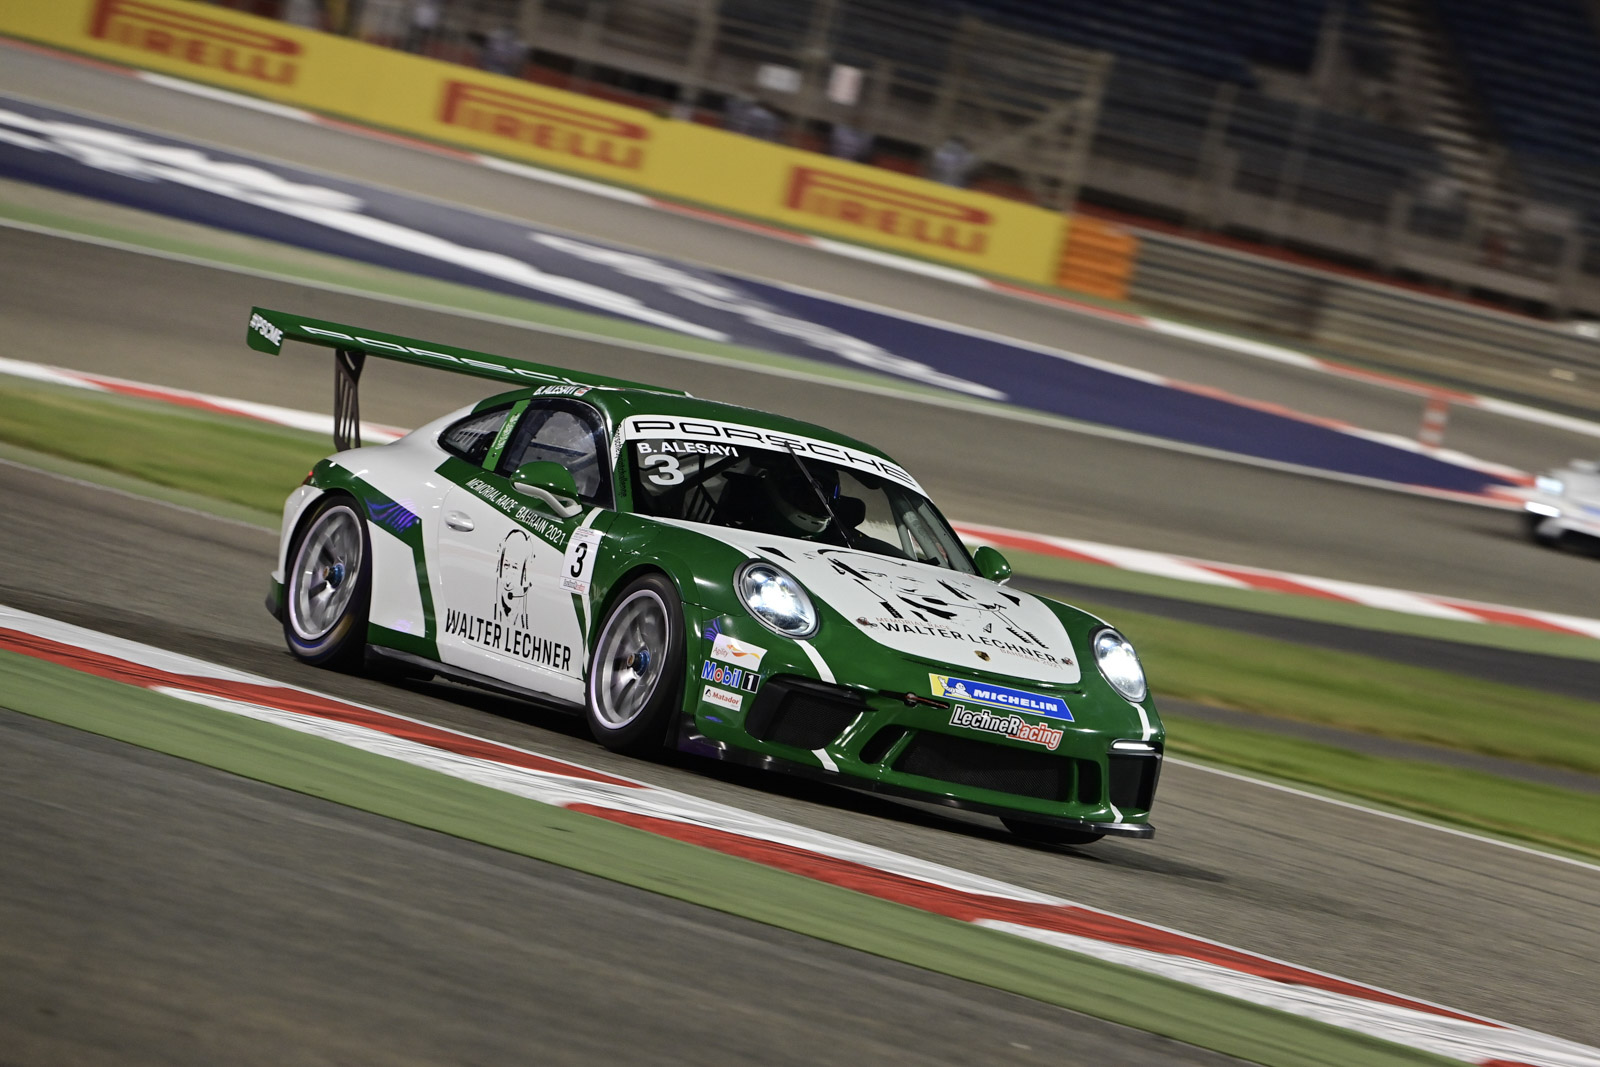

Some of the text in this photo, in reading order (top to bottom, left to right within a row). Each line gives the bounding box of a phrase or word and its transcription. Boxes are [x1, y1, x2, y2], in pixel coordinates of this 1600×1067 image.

[88, 0, 304, 86] PIRELLI
[437, 78, 650, 170] PIRELLI
[779, 165, 992, 254] PIRELLI
[632, 420, 917, 489] PORSCHE
[636, 441, 739, 458] B. ALESAYI
[644, 454, 685, 486] 3
[465, 477, 567, 546] MEMORIAL RACE BAHRAIN 2021
[570, 542, 588, 578] 3
[445, 608, 571, 671] WALTER LECHNER
[880, 622, 1058, 664] WALTER LECHNER
[701, 660, 742, 689] Mobil
[712, 692, 739, 705] Matador
[973, 688, 1058, 712] MICHELIN
